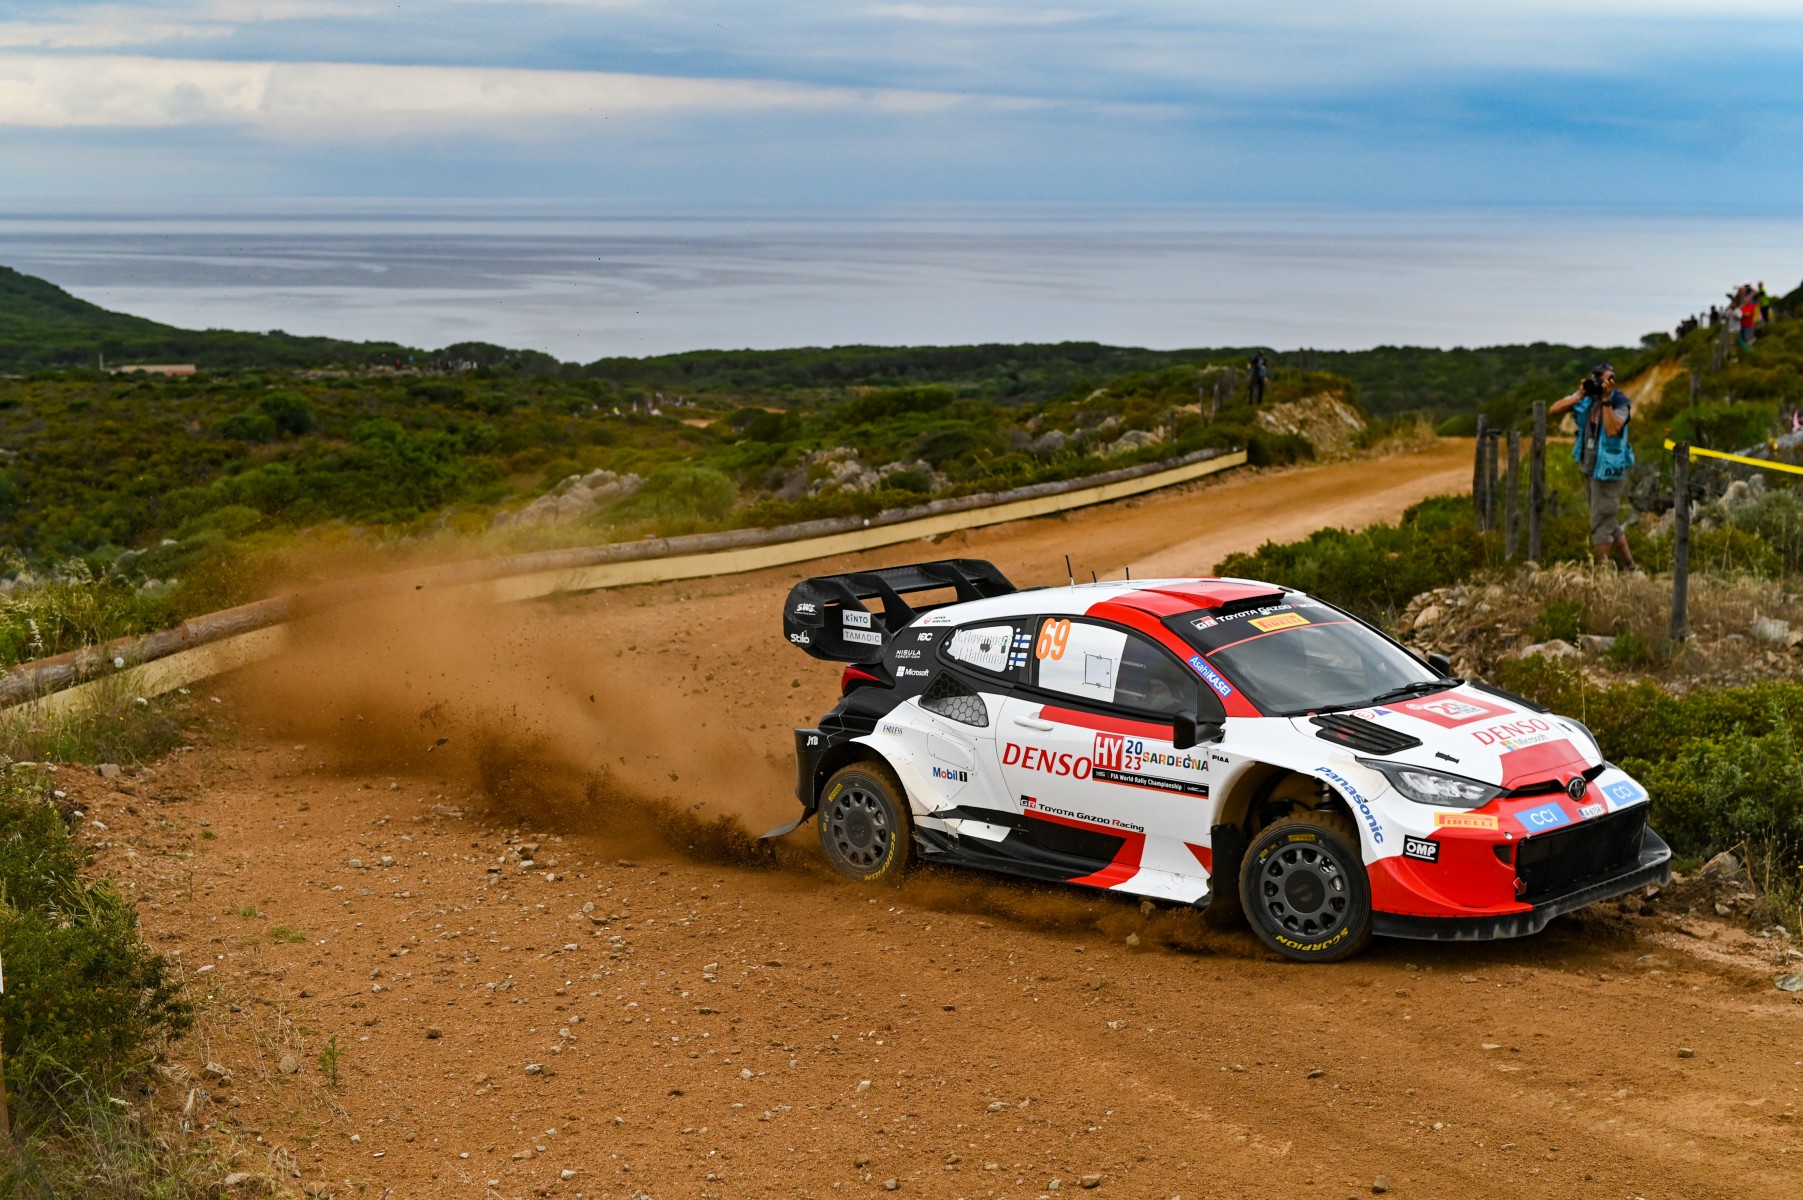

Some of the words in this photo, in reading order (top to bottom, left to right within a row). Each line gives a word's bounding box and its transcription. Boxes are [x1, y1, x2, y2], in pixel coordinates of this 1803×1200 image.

[1216, 609, 1258, 622] TOYOTA
[1256, 615, 1303, 629] PIRELLI
[790, 630, 810, 644] Stilo
[845, 631, 880, 643] TAMADIC
[1036, 617, 1071, 661] 69
[905, 668, 929, 676] Microsoft
[1472, 718, 1550, 745] DENSO
[1095, 736, 1122, 768] HY
[1126, 740, 1143, 755] 20
[1002, 743, 1092, 780] DENSO
[1125, 755, 1141, 770] 23
[1142, 752, 1209, 771] SARDEGNA
[1212, 755, 1230, 763] PIAA
[933, 767, 958, 780] Mobil
[1135, 777, 1147, 785] Rally
[1148, 779, 1182, 791] Championship
[1314, 766, 1384, 844] Panasonic
[1021, 799, 1036, 808] GR
[1039, 803, 1074, 817] TOYOTA
[1077, 812, 1110, 825] GAZOO
[1112, 819, 1144, 832] Racing
[1439, 815, 1493, 827] PIRELLI
[1530, 809, 1557, 826] CCI
[864, 832, 896, 881] SCORPION
[1406, 841, 1436, 857] OMP
[1275, 927, 1349, 951] SCORPION
